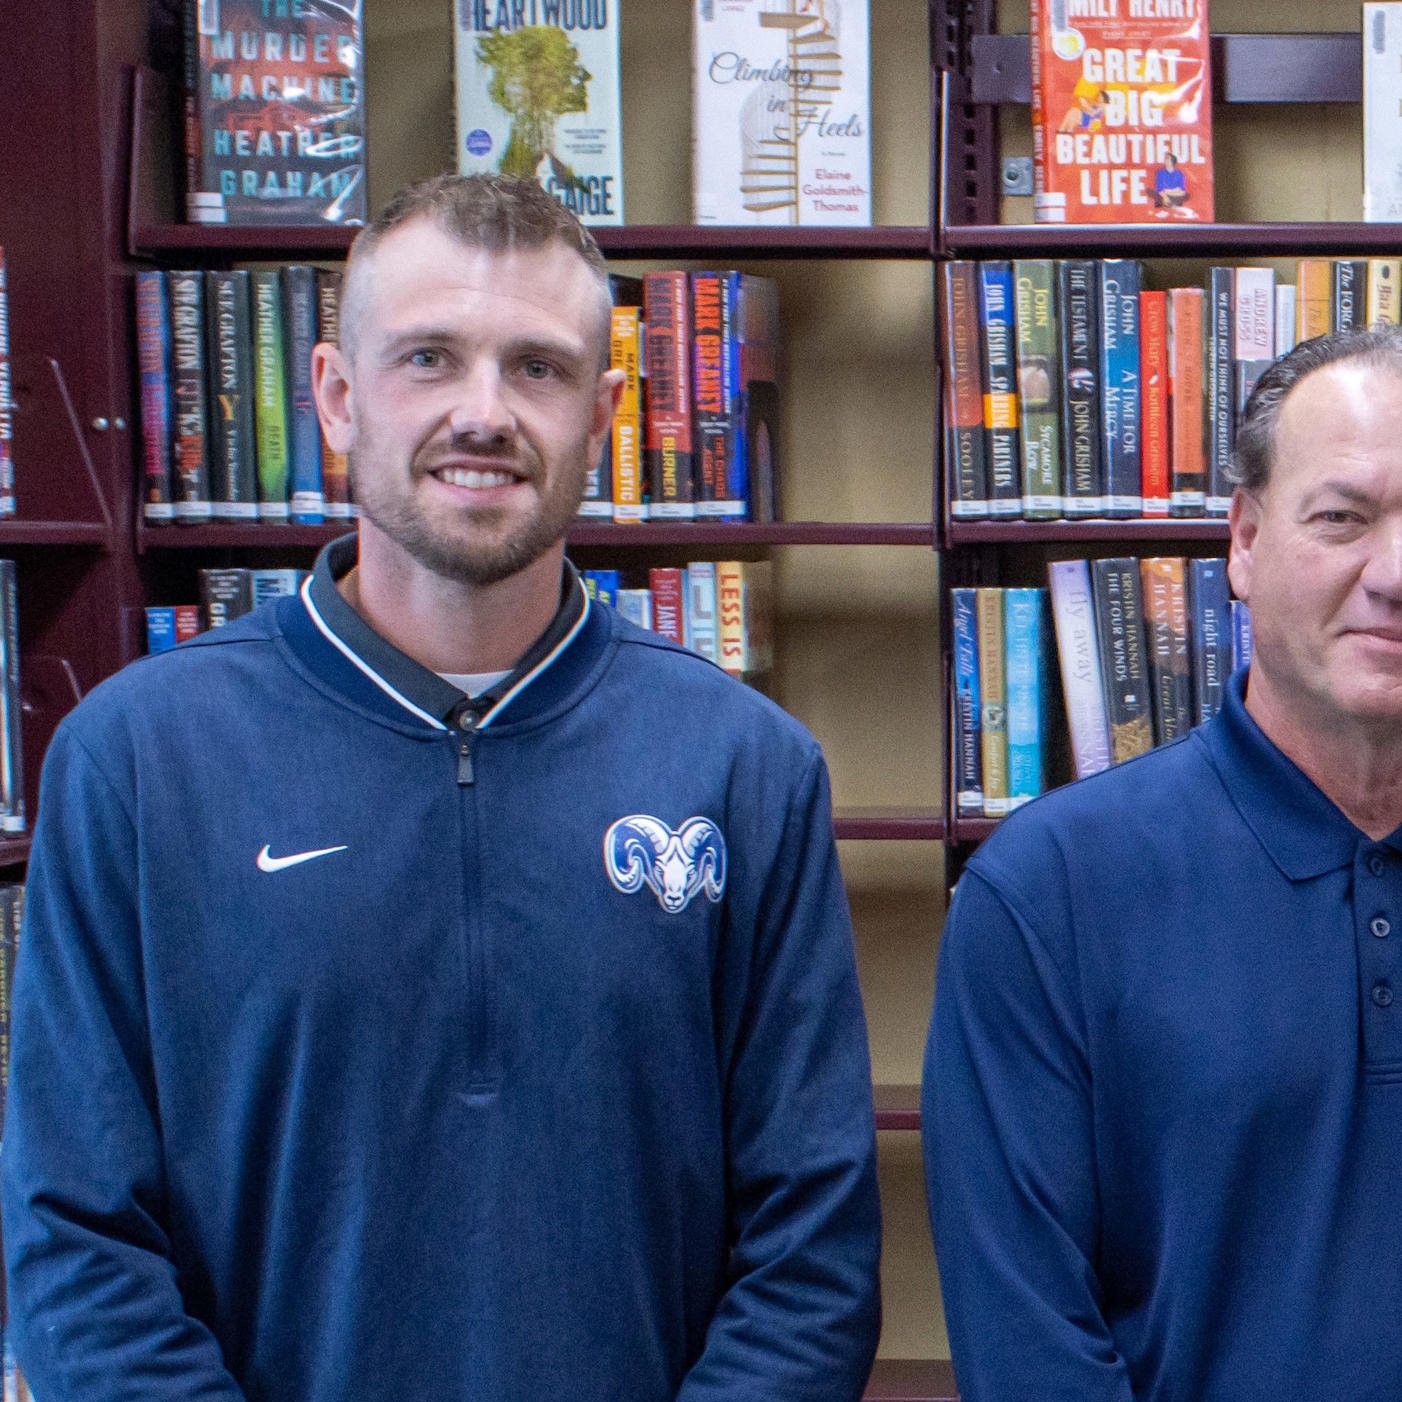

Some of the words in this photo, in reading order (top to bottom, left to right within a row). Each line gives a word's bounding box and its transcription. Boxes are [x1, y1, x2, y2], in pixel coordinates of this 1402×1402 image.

[262, 0, 303, 18] THE
[709, 51, 814, 93] Climbing
[1083, 48, 1182, 82] GREAT
[211, 73, 355, 103] MACHINE
[767, 95, 785, 113] in
[774, 106, 863, 141] Heels
[1104, 90, 1163, 127] BIG
[214, 129, 355, 159] HEATHER
[1056, 134, 1205, 164] BEAUTIFUL
[220, 169, 352, 198] GRAHAM
[815, 168, 852, 180] Elaine
[1081, 169, 1147, 205] LIFE
[813, 200, 859, 212] Thomas
[695, 278, 720, 329] MARK
[1034, 288, 1048, 327] JOHN
[1104, 280, 1120, 350] GRISHAM
[1122, 294, 1136, 335] JOHN
[695, 335, 721, 413] GREANEY
[1070, 400, 1089, 431] JOHN
[619, 426, 634, 501] BALLISTIC
[662, 436, 676, 496] BURNER
[1074, 433, 1091, 491] GRISHAM
[720, 574, 740, 626] LESS
[1109, 599, 1123, 635] FOUR
[1204, 608, 1220, 648] night
[723, 638, 741, 657] IS
[1113, 639, 1128, 681] WINDS
[1125, 625, 1141, 680] HANNAH
[1206, 654, 1220, 687] road
[964, 734, 976, 780] HANNAH
